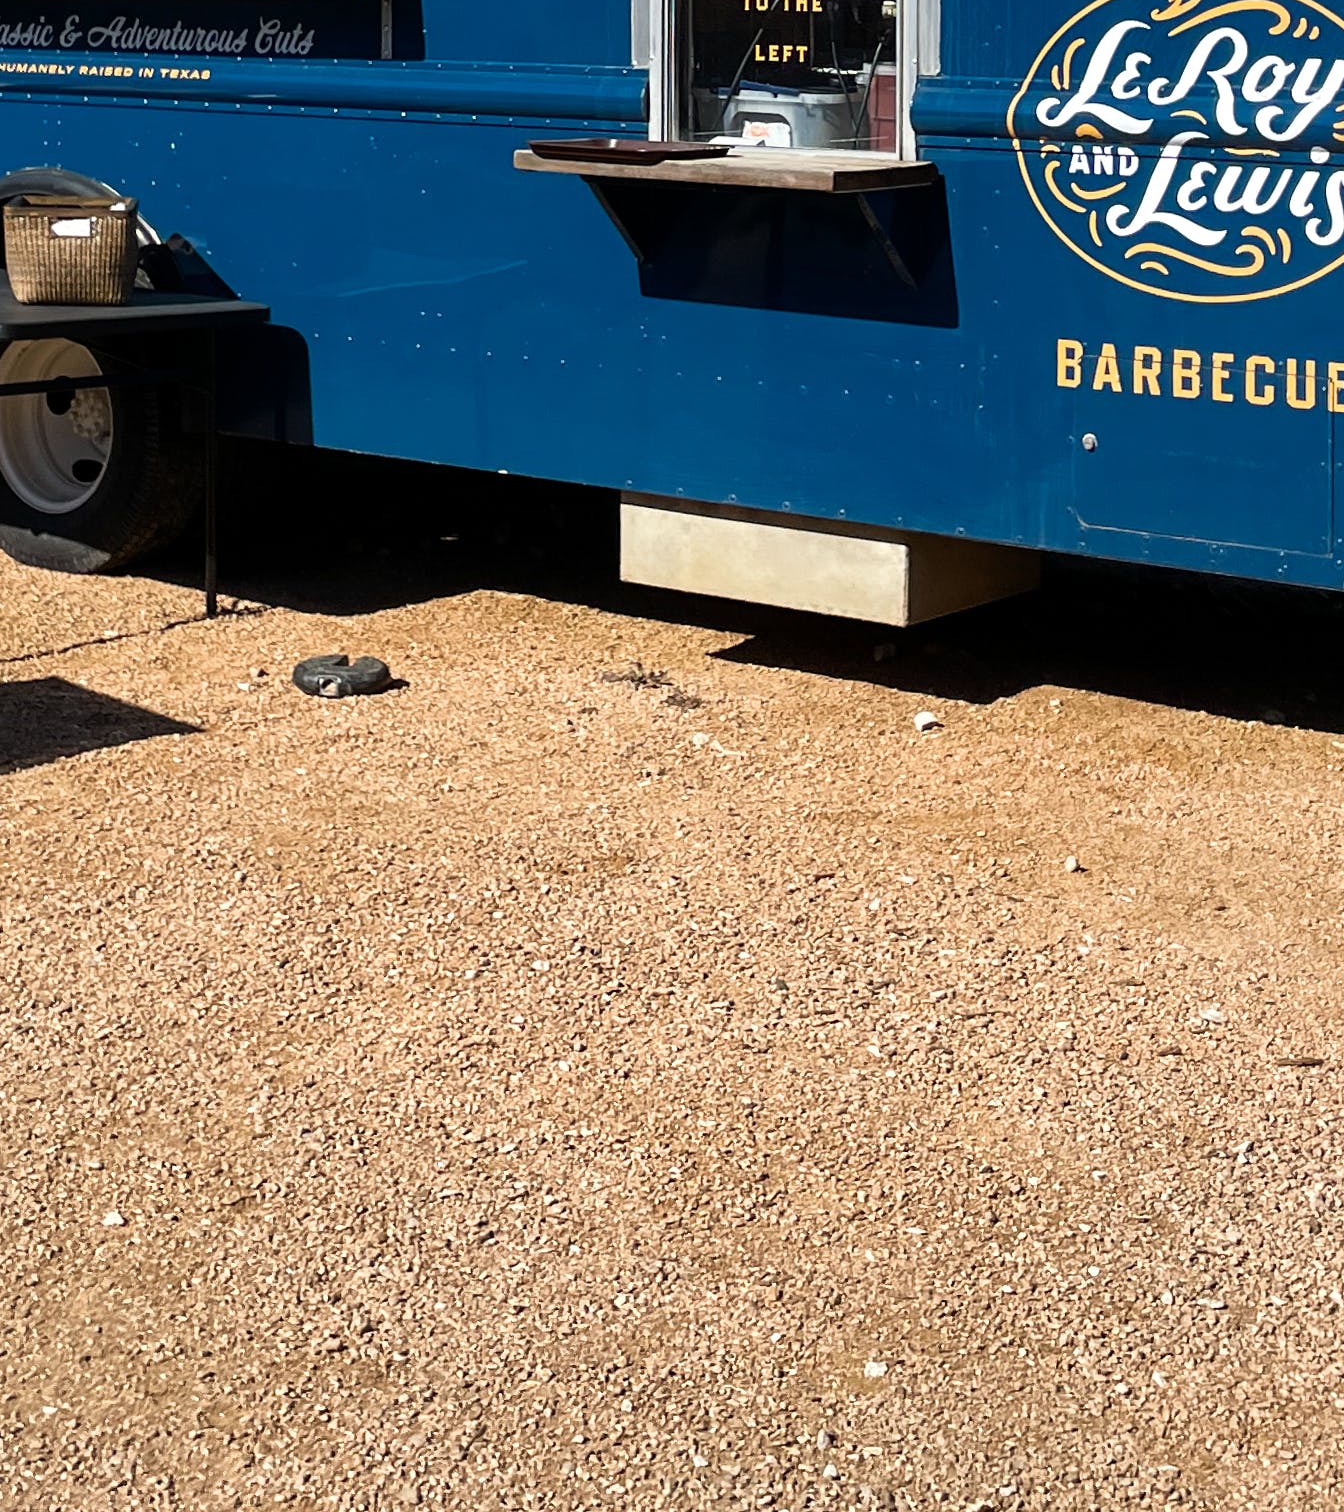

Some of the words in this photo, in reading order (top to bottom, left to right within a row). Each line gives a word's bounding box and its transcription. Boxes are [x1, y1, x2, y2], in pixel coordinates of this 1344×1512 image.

[59, 14, 83, 48] &
[87, 16, 249, 54] Adventurous
[254, 16, 316, 55] Cuts
[754, 44, 809, 63] LEFT
[79, 65, 134, 77] RAISED
[138, 67, 154, 78] IN
[160, 68, 211, 80] TEXAS
[1068, 145, 1140, 177] AND
